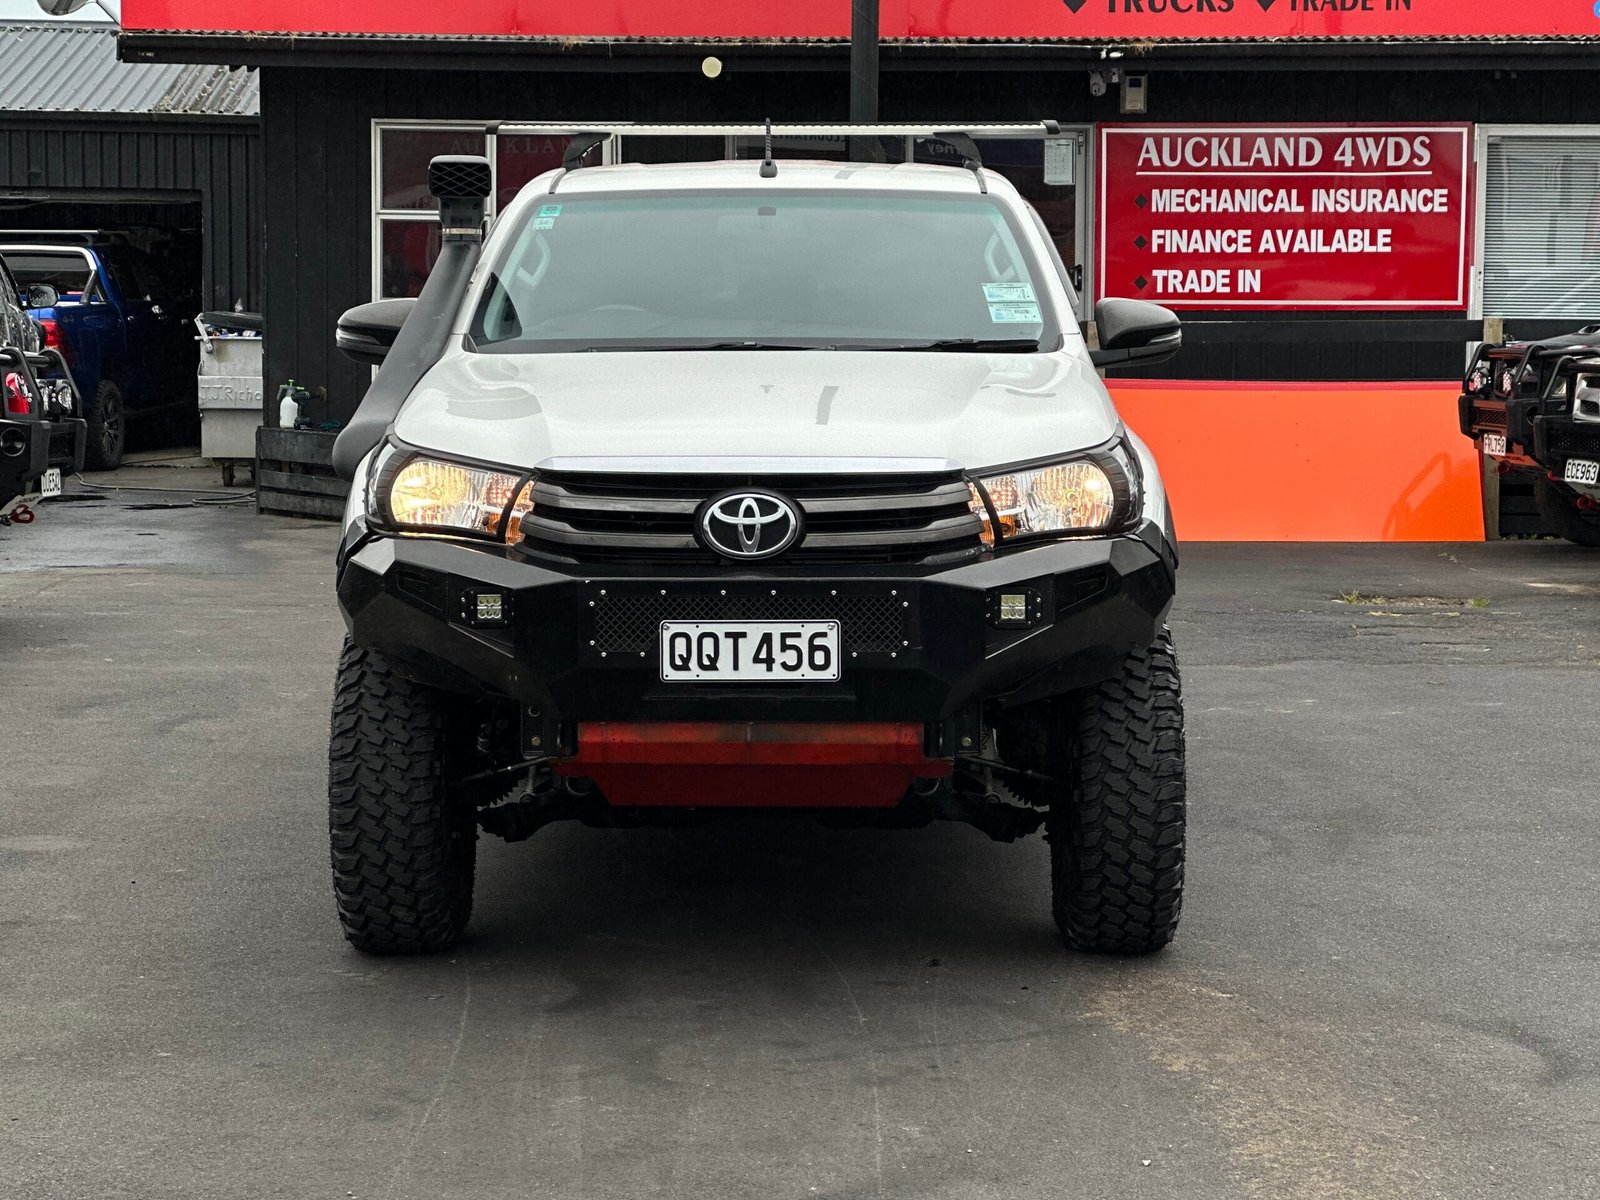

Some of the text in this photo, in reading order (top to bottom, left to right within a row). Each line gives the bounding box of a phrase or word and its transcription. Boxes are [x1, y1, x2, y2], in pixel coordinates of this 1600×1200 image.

[1136, 136, 1431, 167] AUCKLAND 4WDS
[1151, 188, 1449, 213] MECHANICAL INSURANCE
[1151, 228, 1392, 254] FINANCE AVAILABLE
[1152, 269, 1261, 293] TRADE IN
[1566, 461, 1598, 482] ECE963
[668, 631, 832, 672] QQT456
